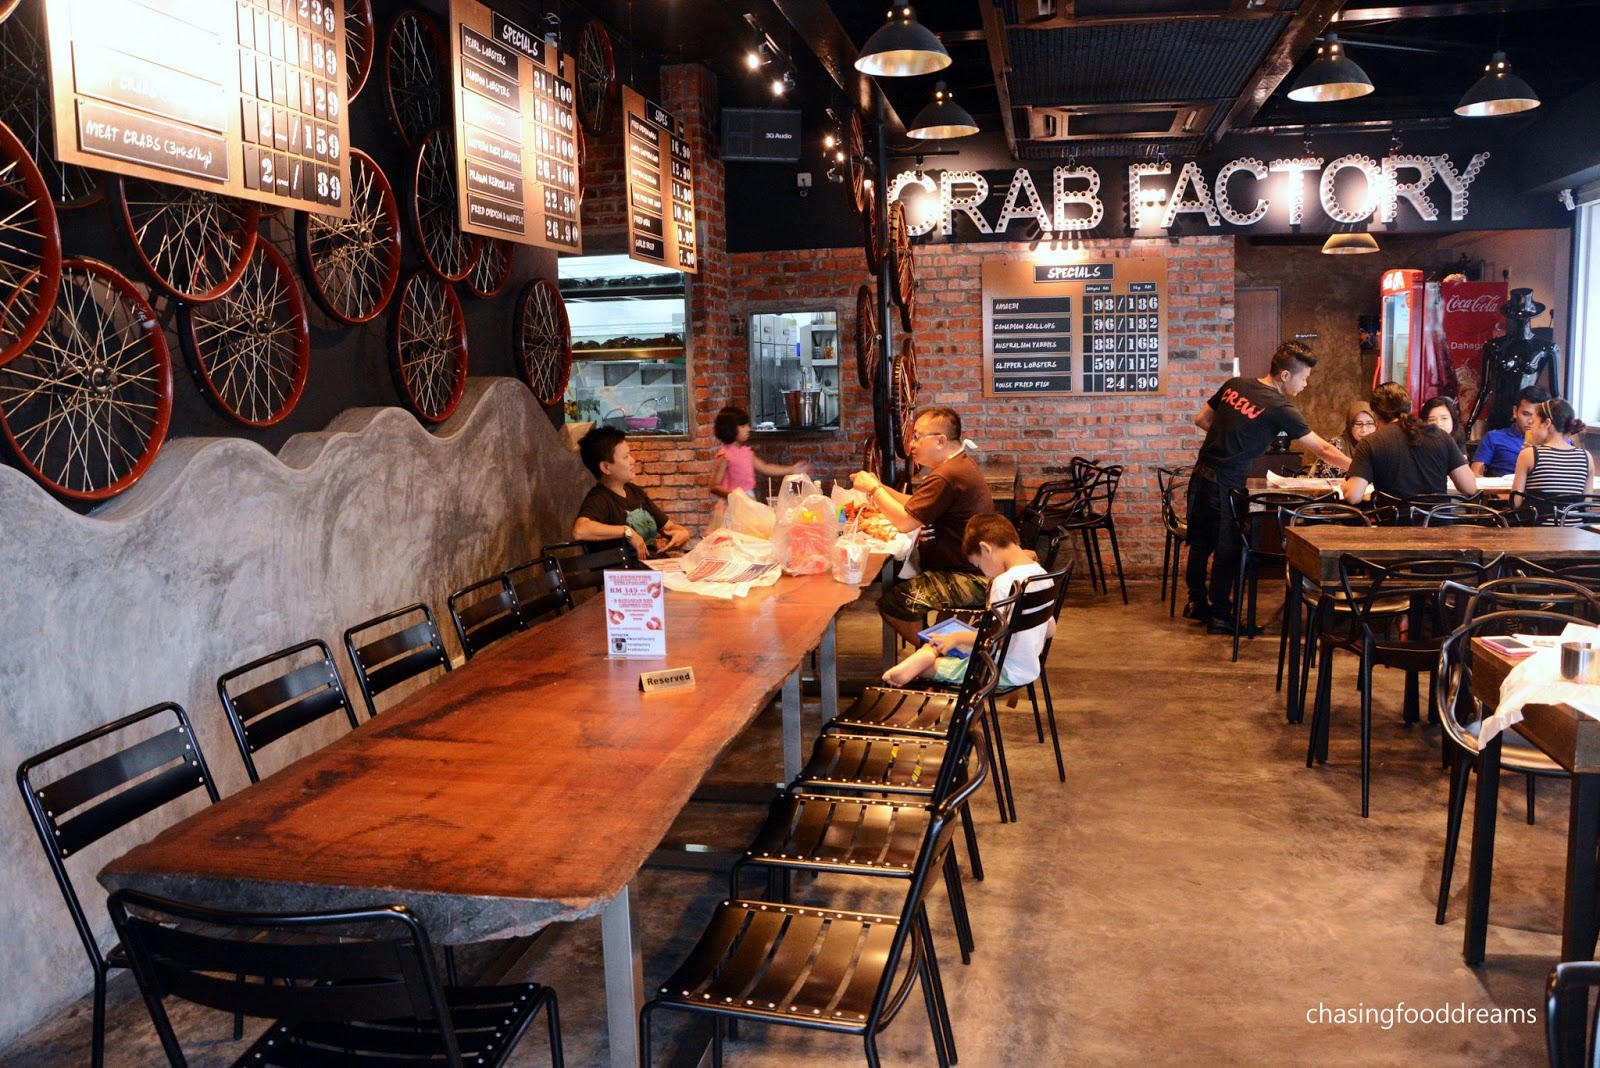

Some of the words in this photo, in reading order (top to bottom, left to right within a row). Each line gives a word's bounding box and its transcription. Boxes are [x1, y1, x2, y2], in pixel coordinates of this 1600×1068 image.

[502, 24, 539, 57] SPECIALS
[481, 44, 507, 66] LOBSTERS
[85, 119, 120, 142] MEAT
[122, 129, 162, 152] CRABS
[544, 190, 576, 214] 22.90
[888, 166, 1104, 237] CRAB
[1129, 151, 1491, 228] FACTORY
[546, 220, 579, 242] 26.90
[1047, 266, 1101, 279] SPECIALS
[1025, 322, 1056, 330] SCALLOPS
[995, 361, 1022, 369] SLIPPER
[1023, 361, 1057, 369] LOBSTERS
[1094, 357, 1158, 371] 59/112
[1106, 376, 1158, 389] 24.90
[1221, 388, 1266, 419] CREW
[647, 672, 690, 686] Reserved
